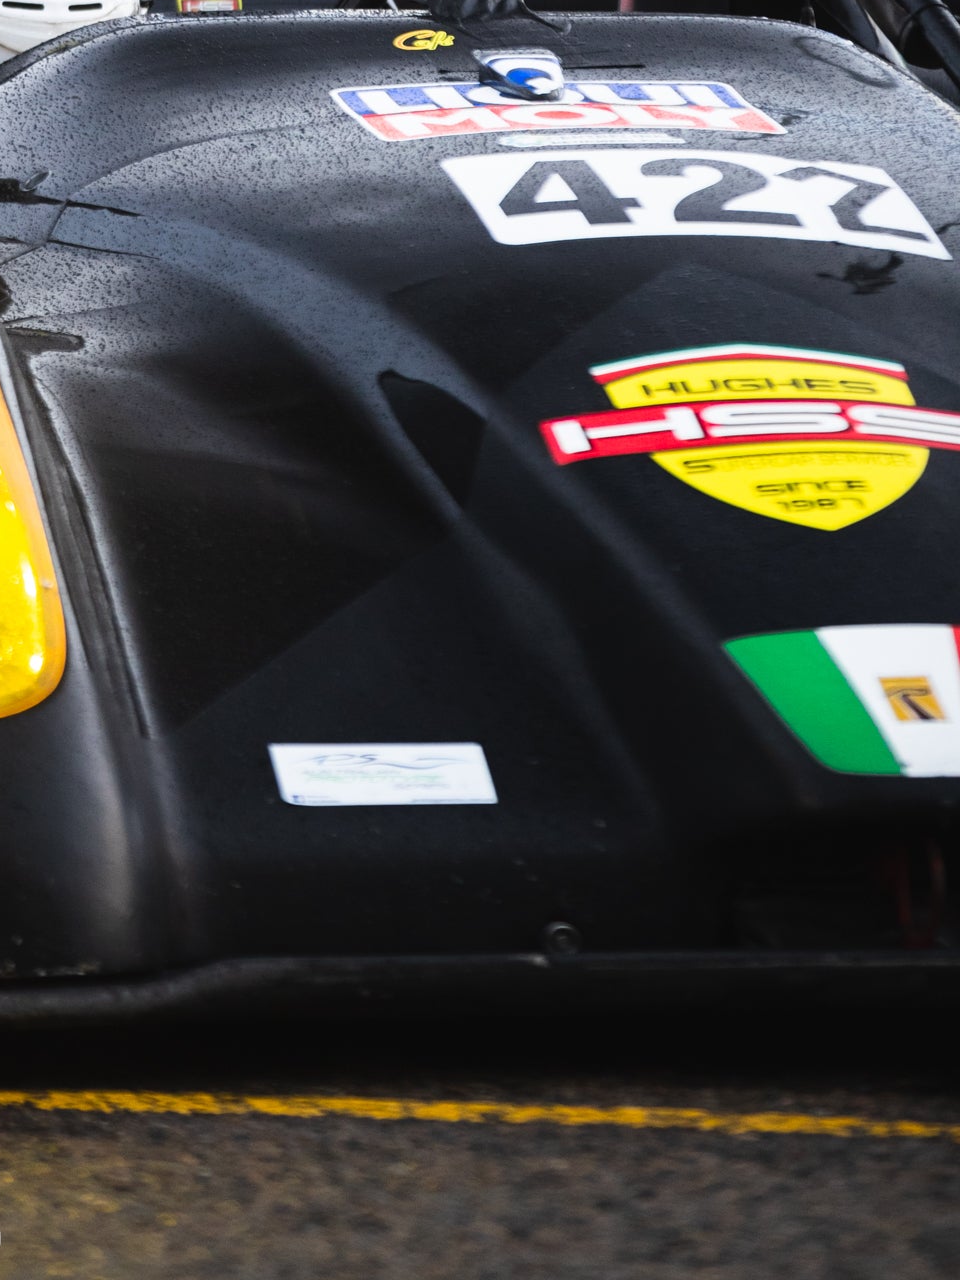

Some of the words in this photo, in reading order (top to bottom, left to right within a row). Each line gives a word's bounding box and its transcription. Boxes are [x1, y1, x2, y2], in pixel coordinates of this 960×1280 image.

[384, 104, 748, 136] MOLY
[499, 158, 930, 241] 422
[641, 377, 880, 397] HUGHES
[550, 401, 960, 455] HSS
[777, 498, 865, 511] 1987
